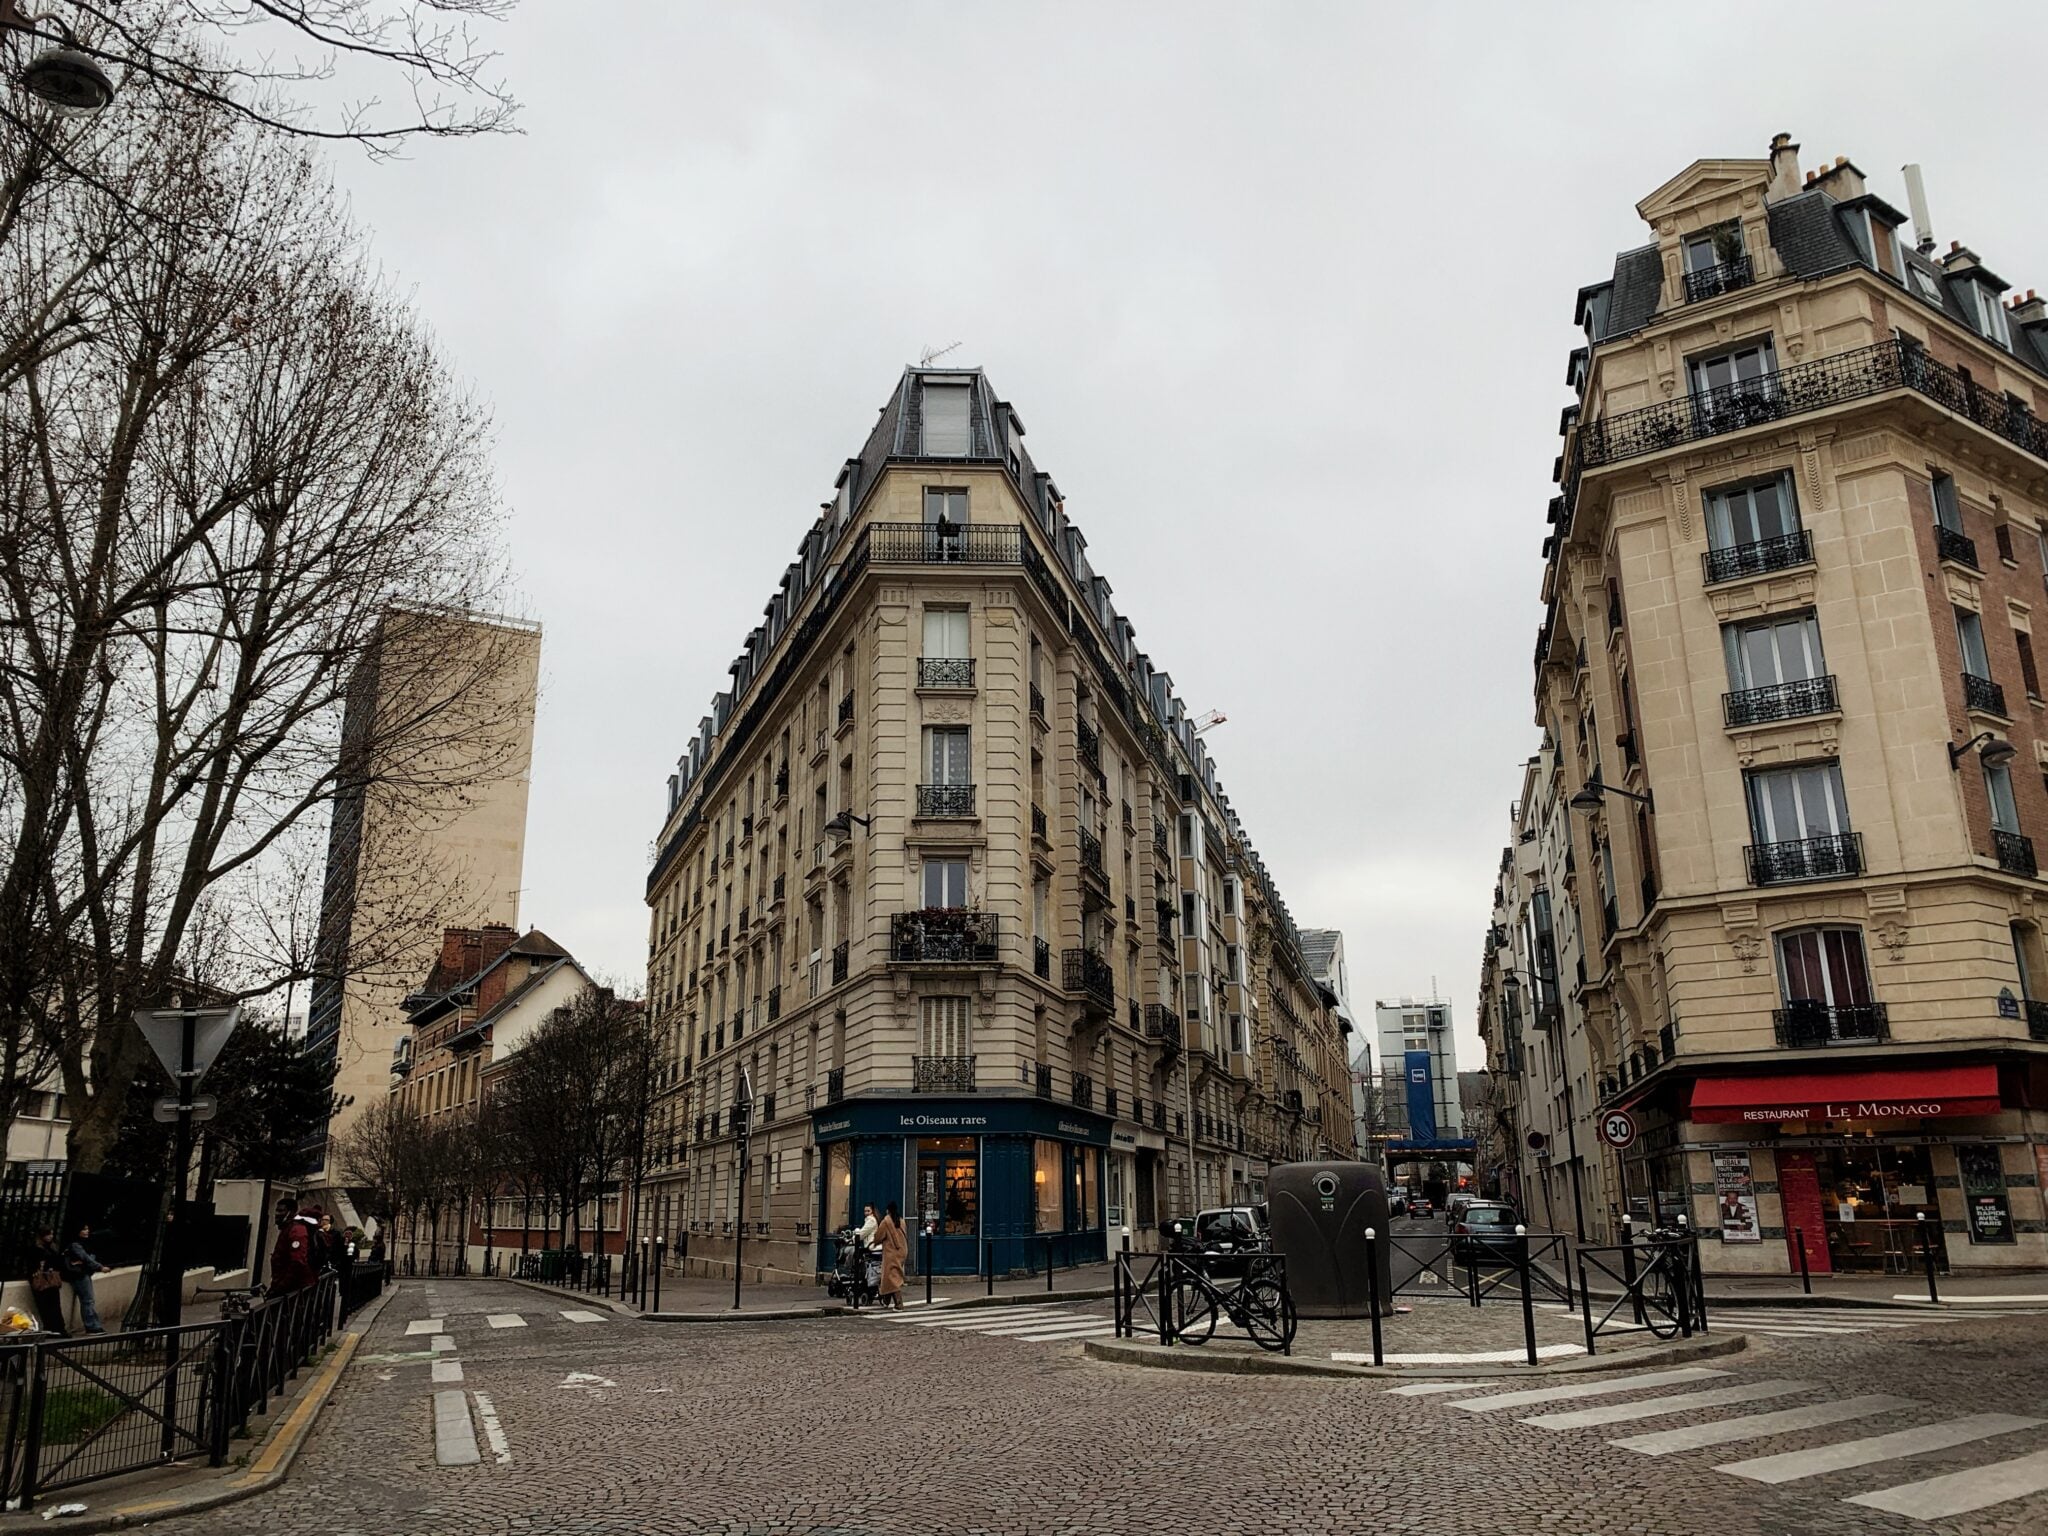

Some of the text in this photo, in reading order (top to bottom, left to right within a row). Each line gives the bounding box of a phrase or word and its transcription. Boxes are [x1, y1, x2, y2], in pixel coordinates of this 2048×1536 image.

[900, 1115, 987, 1125] les Oiseaux rares
[1743, 1109, 1810, 1120] RESTAURANT
[1608, 1120, 1630, 1138] 30
